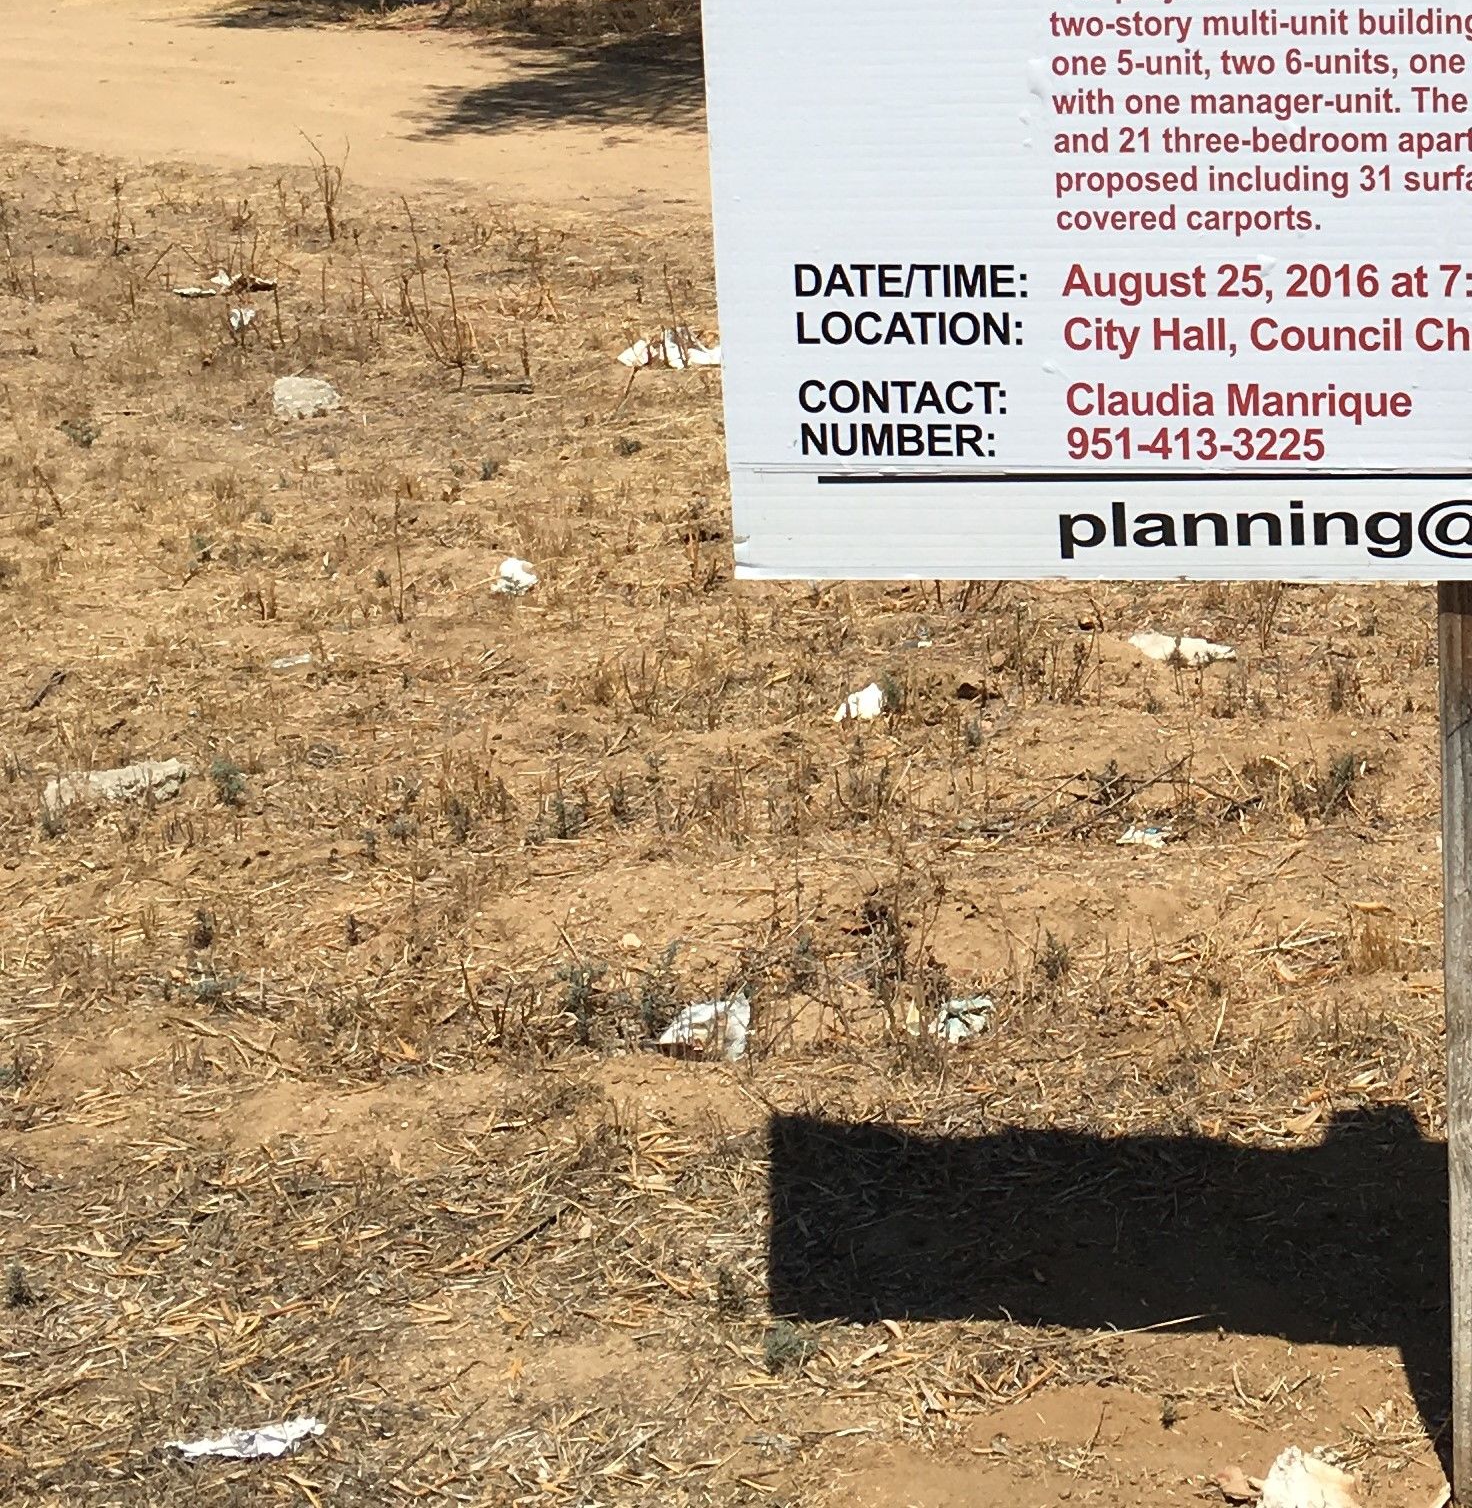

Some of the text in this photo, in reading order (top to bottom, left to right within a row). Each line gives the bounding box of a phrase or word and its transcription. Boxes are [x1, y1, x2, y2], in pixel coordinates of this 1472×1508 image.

[1049, 10, 1193, 44] two-story
[1202, 8, 1349, 37] multi-unit
[1051, 55, 1107, 77] one
[1117, 48, 1211, 80] 5-unit,
[1219, 49, 1276, 76] two
[1285, 47, 1399, 80] 6-units,
[1409, 53, 1466, 75] one
[1051, 87, 1115, 115] with
[1125, 93, 1181, 115] one
[1190, 86, 1401, 121] manager-unit.
[1410, 86, 1469, 114] The
[1054, 126, 1109, 154] and
[1118, 126, 1150, 154] 21
[1161, 125, 1388, 154] three-bedroom
[1055, 164, 1198, 199] proposed
[1208, 164, 1349, 199] including
[1359, 164, 1391, 192] 31
[1056, 203, 1321, 238] covered carports.
[793, 263, 1028, 299] DATE/TIME:
[1061, 263, 1207, 307] August
[1216, 263, 1273, 304] 25,
[1285, 263, 1380, 299] 2016
[1391, 265, 1429, 298] at
[796, 310, 1023, 346] LOCATION:
[1063, 316, 1141, 360] City
[1153, 317, 1237, 358] Hall,
[1250, 317, 1402, 352] Council
[798, 379, 1413, 426] CONTACT: Claudia Manrique
[800, 422, 1325, 462] NUMBER: 951-413-3225
